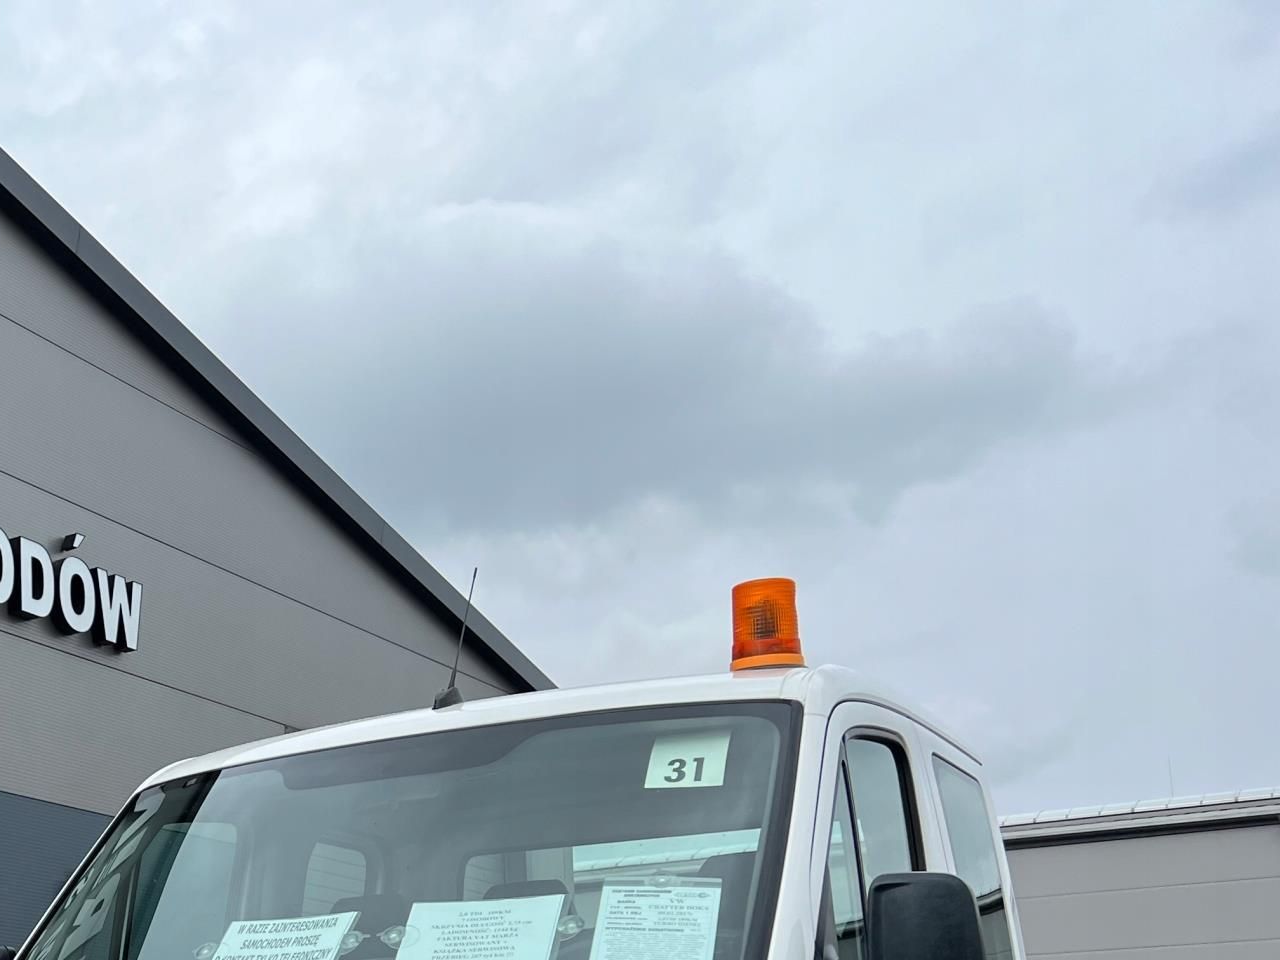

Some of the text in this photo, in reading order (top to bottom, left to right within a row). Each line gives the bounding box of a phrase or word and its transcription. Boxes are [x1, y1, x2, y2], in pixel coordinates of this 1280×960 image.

[664, 756, 705, 783] 31
[237, 917, 339, 935] W RAZIE ZAINTERESOWANIA
[240, 936, 293, 950] SAMOCHODEM
